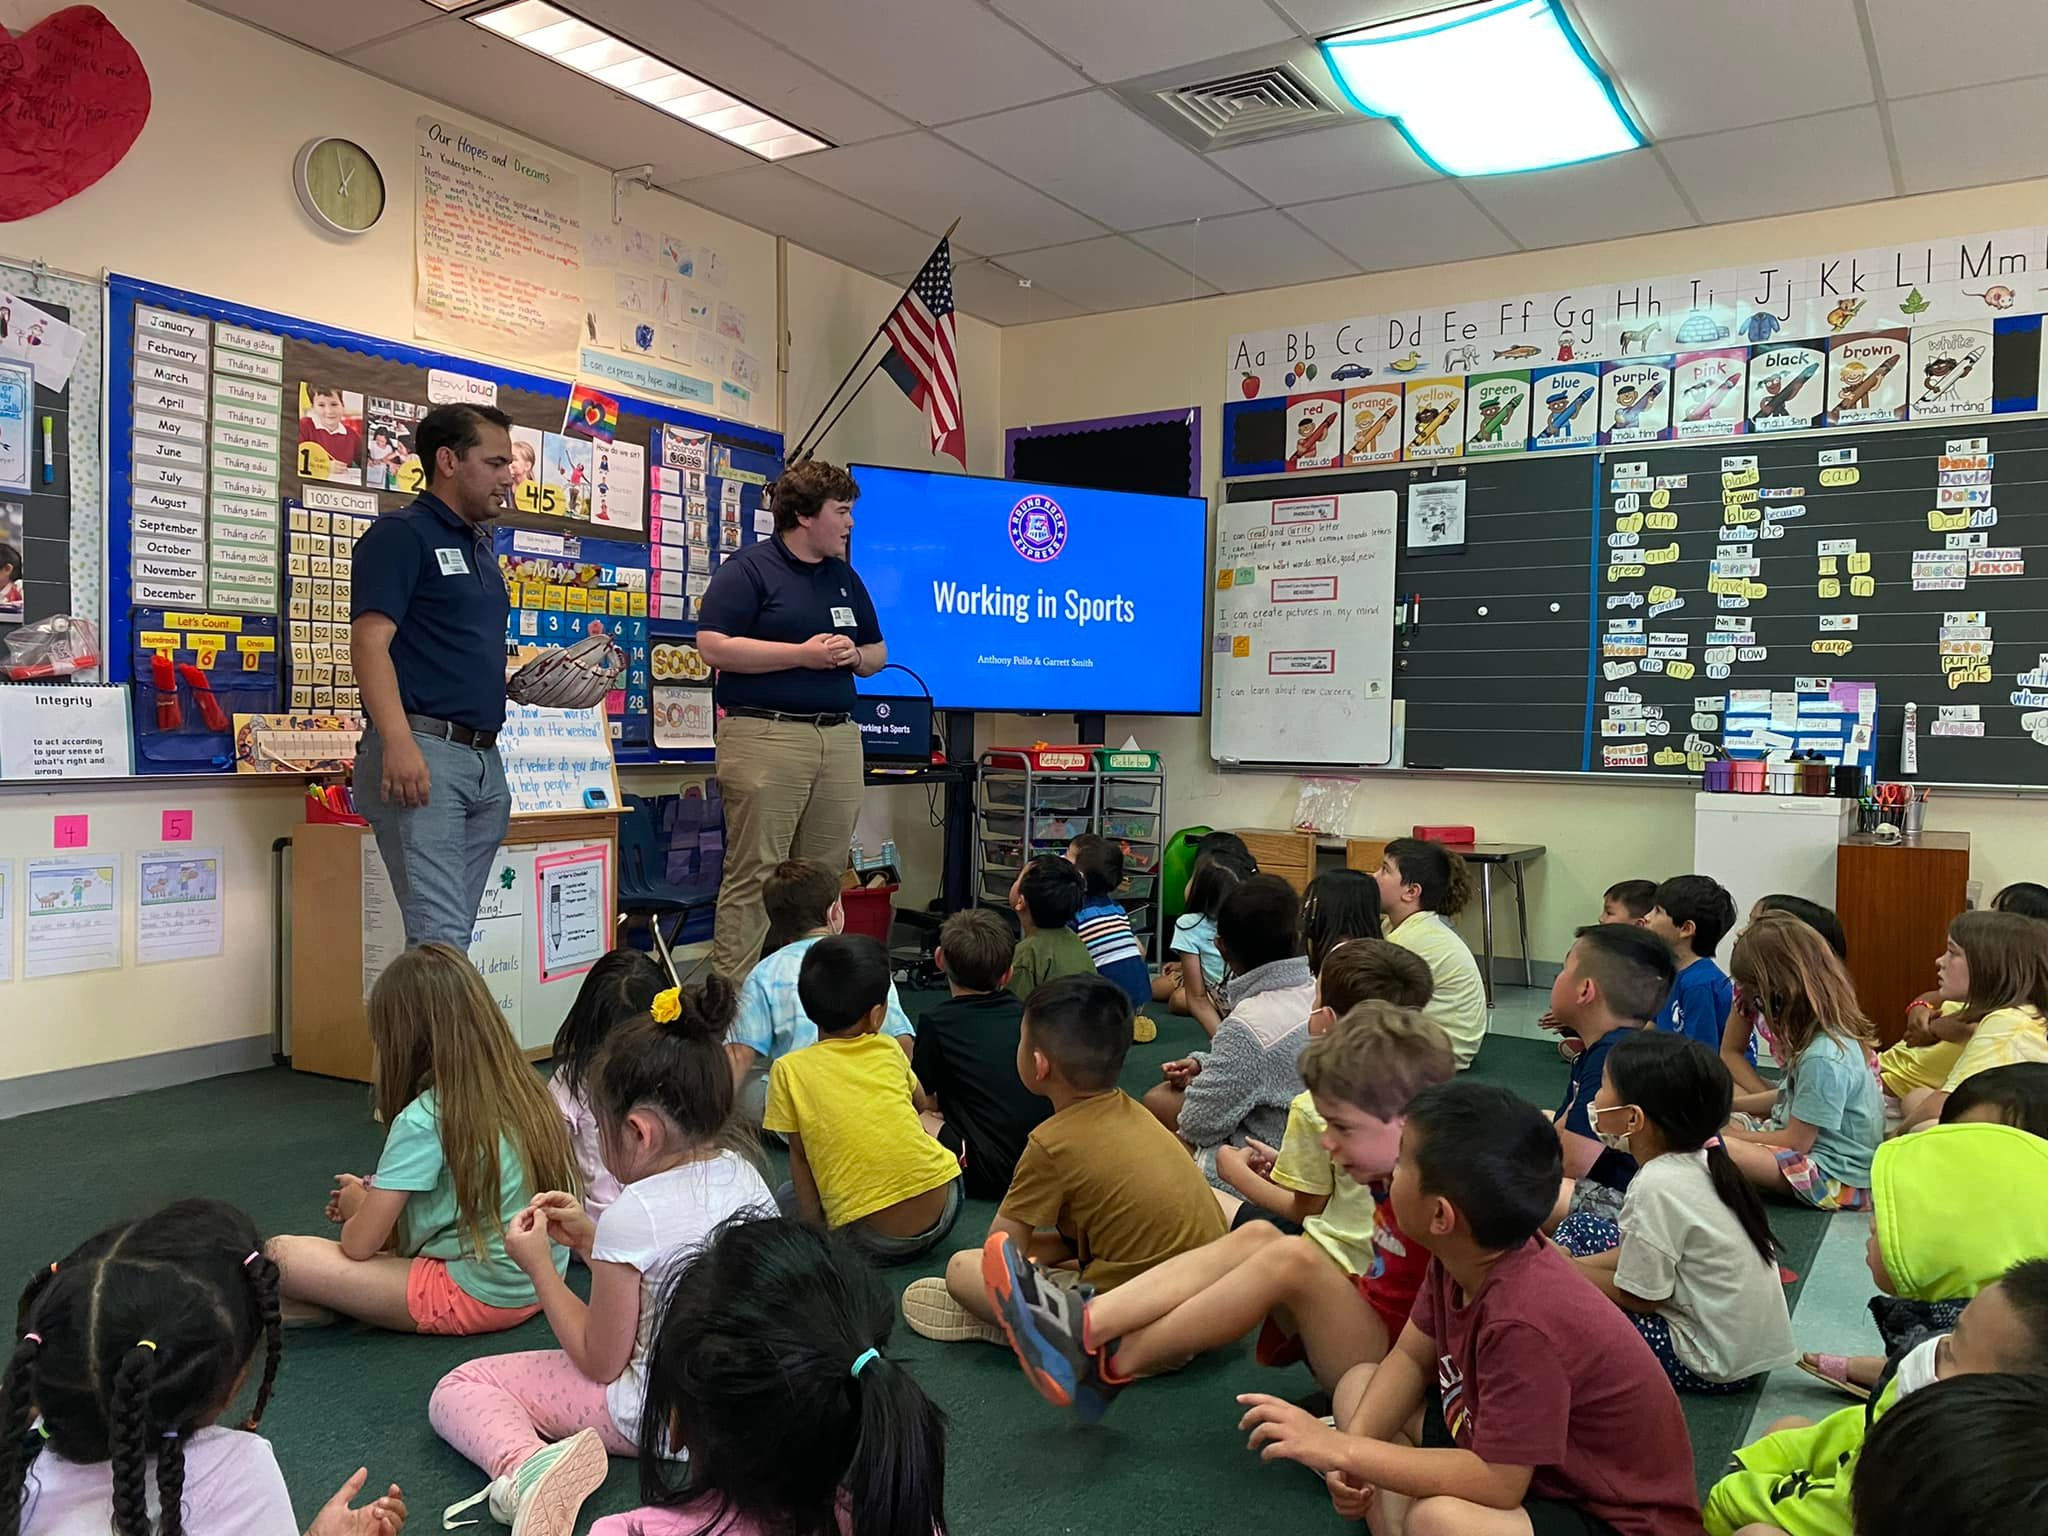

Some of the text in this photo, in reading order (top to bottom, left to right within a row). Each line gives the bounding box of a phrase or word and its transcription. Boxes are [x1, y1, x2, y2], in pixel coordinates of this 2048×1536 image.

[428, 123, 551, 184] Our Hopes and Dreams
[150, 315, 195, 336] January
[1928, 335, 1976, 351] white
[147, 340, 198, 363] February
[1843, 345, 1893, 359] brown
[1765, 352, 1810, 367] black
[154, 367, 188, 385] March
[255, 364, 269, 375] hai
[582, 353, 646, 385] I can express my
[1694, 361, 1727, 379] pink
[1552, 376, 1580, 389] blue
[1613, 368, 1660, 387] purple
[256, 390, 267, 401] ba
[467, 380, 494, 397] loud
[1480, 385, 1517, 400] green
[158, 395, 184, 409] April
[1351, 396, 1393, 411] orange
[1416, 390, 1454, 403] yellow
[1303, 402, 1324, 415] red
[158, 420, 181, 435] May
[156, 445, 182, 458] June
[1375, 451, 1394, 460] cam
[300, 449, 312, 476] 1
[159, 470, 182, 485] July
[1821, 468, 1856, 483] can
[150, 495, 187, 509] August
[310, 492, 372, 510] 100's Chart
[526, 485, 538, 508] 4
[543, 489, 555, 511] 5
[1618, 496, 1638, 511] all
[1941, 488, 1989, 505] Daisy
[1012, 499, 1064, 528] ROUND ROCK
[1648, 513, 1676, 527] am
[1728, 508, 1758, 523] blue
[1931, 510, 1969, 528] Dad
[1969, 510, 1994, 527] did
[139, 519, 198, 535] September
[1721, 526, 1758, 540] brother
[1762, 521, 1782, 538] be
[1609, 532, 1636, 546] are
[147, 542, 192, 556] October
[1016, 539, 1060, 559] EXPRESS
[1646, 547, 1677, 561] and
[143, 564, 197, 578] November
[314, 562, 329, 573] 22
[335, 564, 349, 576] 23
[533, 561, 569, 584] May
[601, 569, 611, 582] 17
[1971, 562, 2023, 574] Jaxon
[1853, 577, 1872, 594] in
[143, 587, 196, 601] December
[1651, 587, 1673, 603] go
[1719, 594, 1747, 608] here
[933, 580, 1135, 627] Working in Sports
[1220, 606, 1380, 622] I can create pictures in my mind
[177, 616, 229, 629] Let's Count
[549, 616, 558, 631] 3
[571, 618, 581, 633] 4
[614, 620, 622, 635] 6
[633, 621, 641, 636] 7
[314, 625, 329, 638] 52
[201, 650, 212, 665] 6
[245, 653, 256, 668] 0
[335, 648, 350, 660] 63
[632, 647, 644, 660] 14
[977, 654, 1093, 668] Anthony Pollo & Garrett Smith
[1739, 648, 1765, 660] now
[1642, 660, 1661, 671] me
[1668, 663, 1692, 678] my
[1710, 665, 1729, 677] no
[1944, 655, 1988, 673] purple
[632, 671, 644, 685] 21
[1952, 669, 1988, 688] pink
[316, 691, 331, 704] 82
[1216, 688, 1221, 699] I
[1231, 688, 1245, 697] can
[1250, 685, 1270, 695] learn
[1275, 685, 1297, 695] about
[35, 695, 93, 708] Integrity
[630, 695, 644, 708] 28
[517, 721, 530, 735] do
[533, 724, 545, 735] on
[548, 719, 566, 736] the
[890, 724, 910, 734] Sports
[33, 738, 42, 746] to
[62, 737, 103, 747] according
[33, 747, 104, 757] to your sense of
[34, 756, 105, 767] what's right and
[514, 757, 588, 777] of vehicle do you
[1040, 754, 1083, 767] Ketchup box
[1137, 757, 1149, 766] box
[1604, 756, 1648, 766] Samuel
[34, 768, 63, 776] wrong
[519, 778, 541, 794] help
[519, 800, 553, 811] become
[65, 825, 76, 844] 4
[170, 818, 184, 838] 5
[487, 959, 519, 974] details
